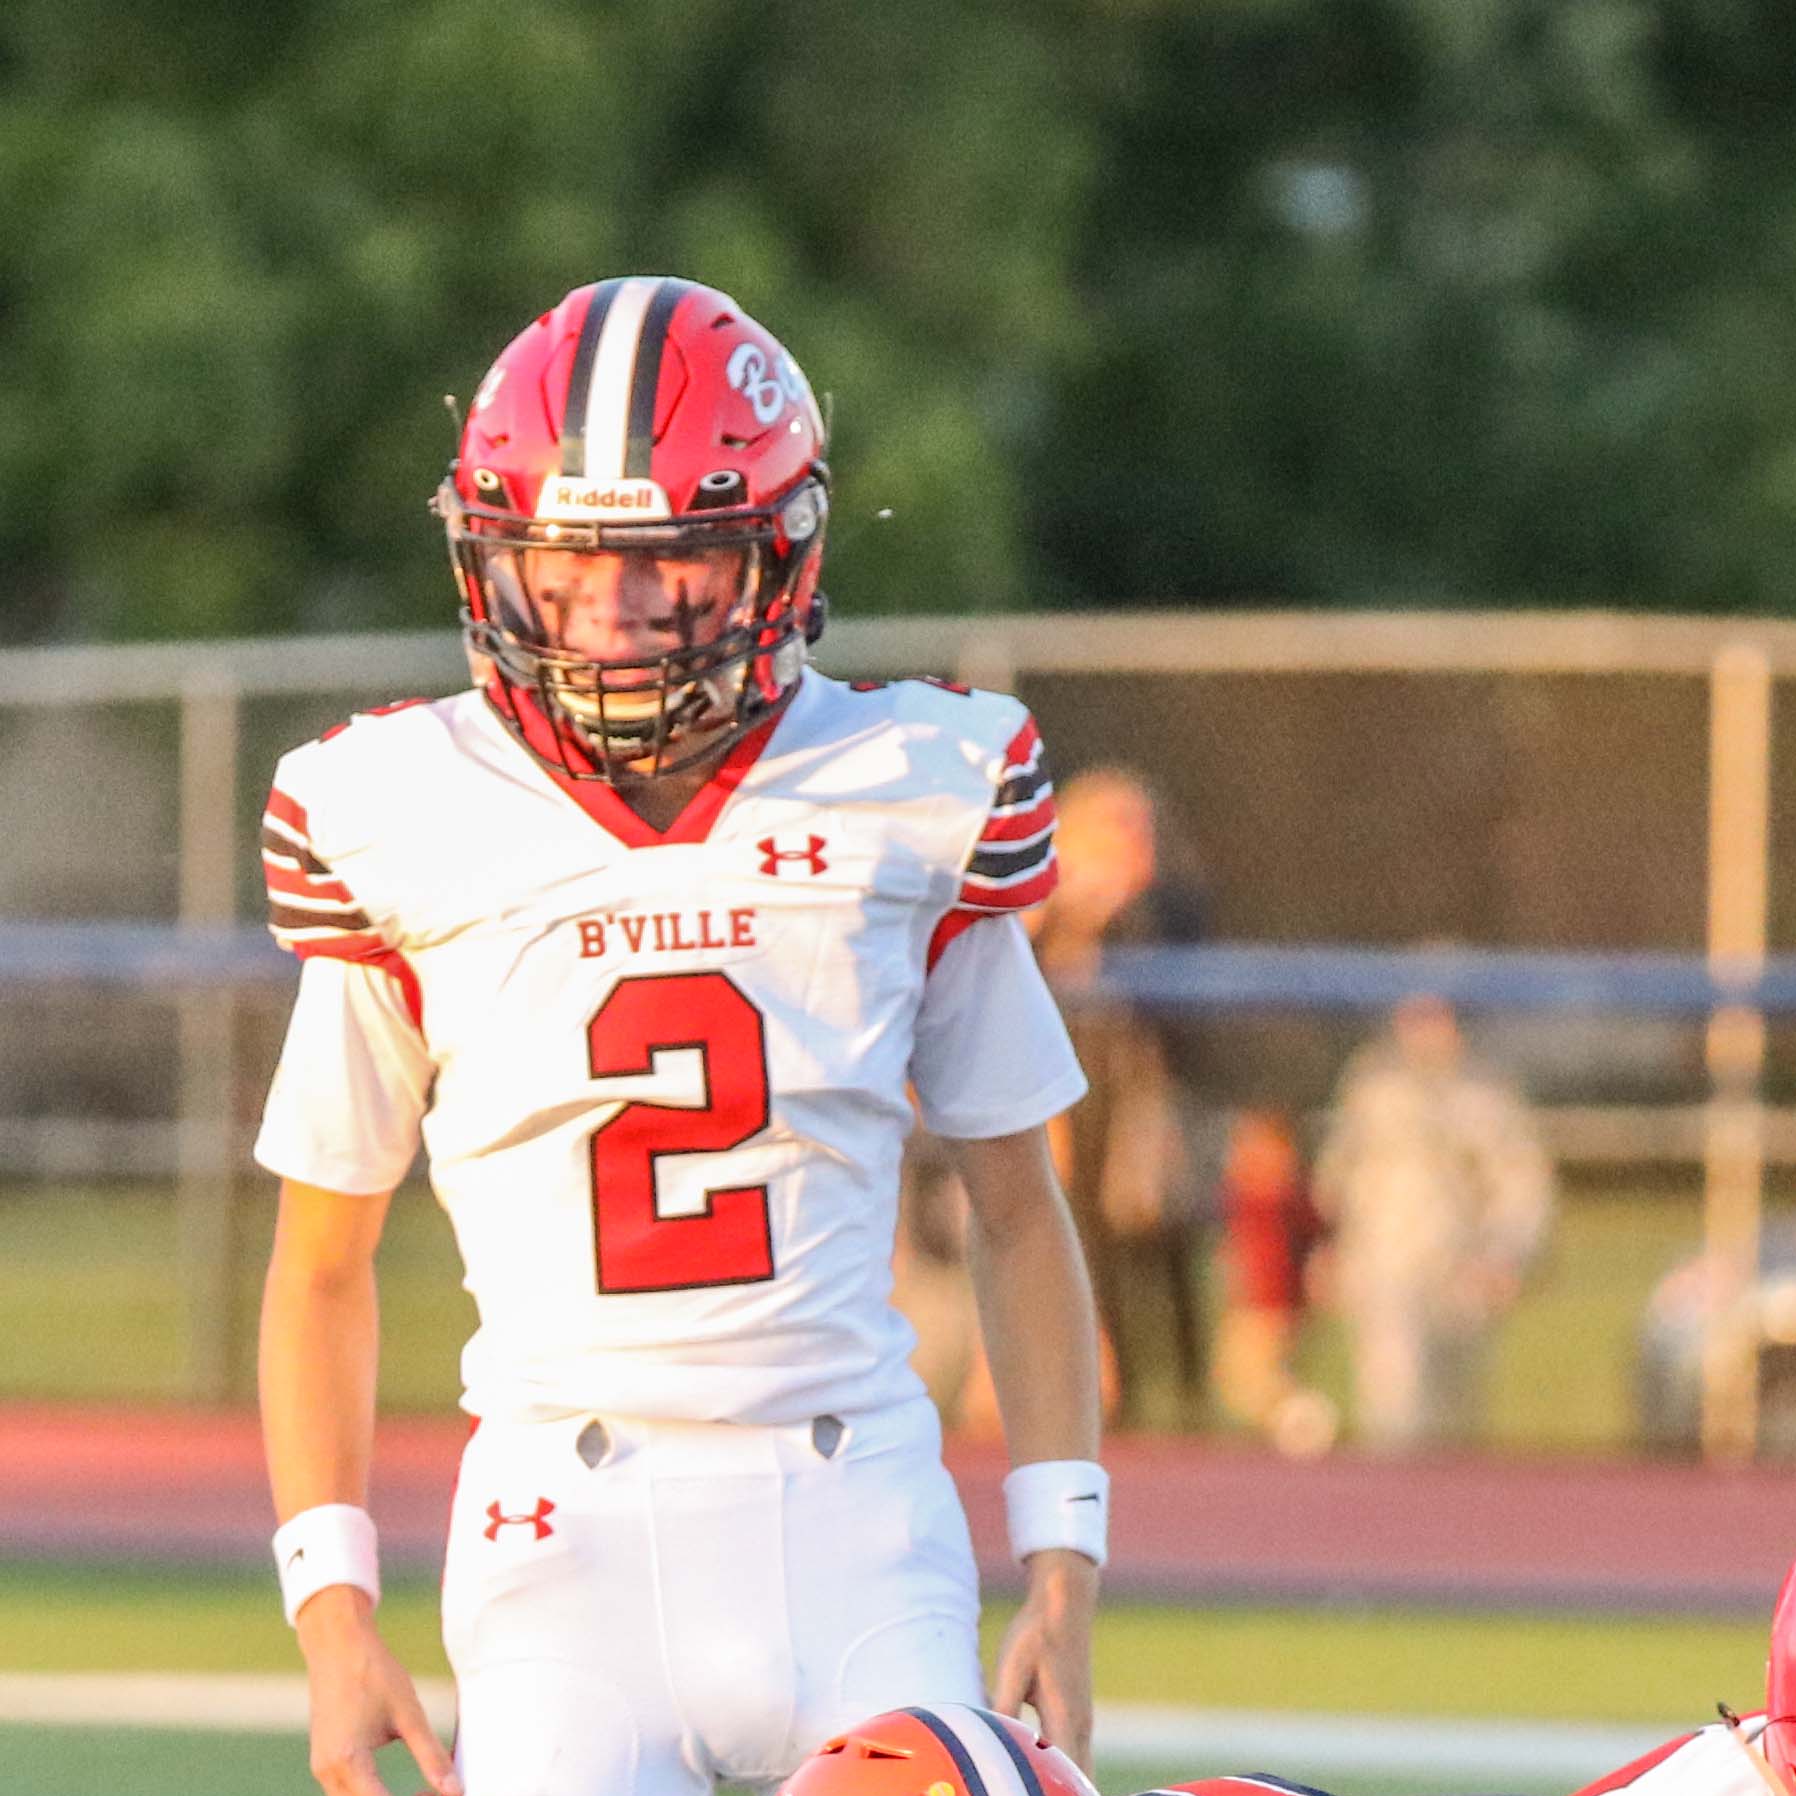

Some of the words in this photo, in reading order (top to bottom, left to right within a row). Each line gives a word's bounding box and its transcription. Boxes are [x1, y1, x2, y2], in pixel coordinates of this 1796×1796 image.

[557, 487, 654, 508] Riddell
[577, 907, 757, 958] B'VILLE
[587, 969, 774, 1295] 2
